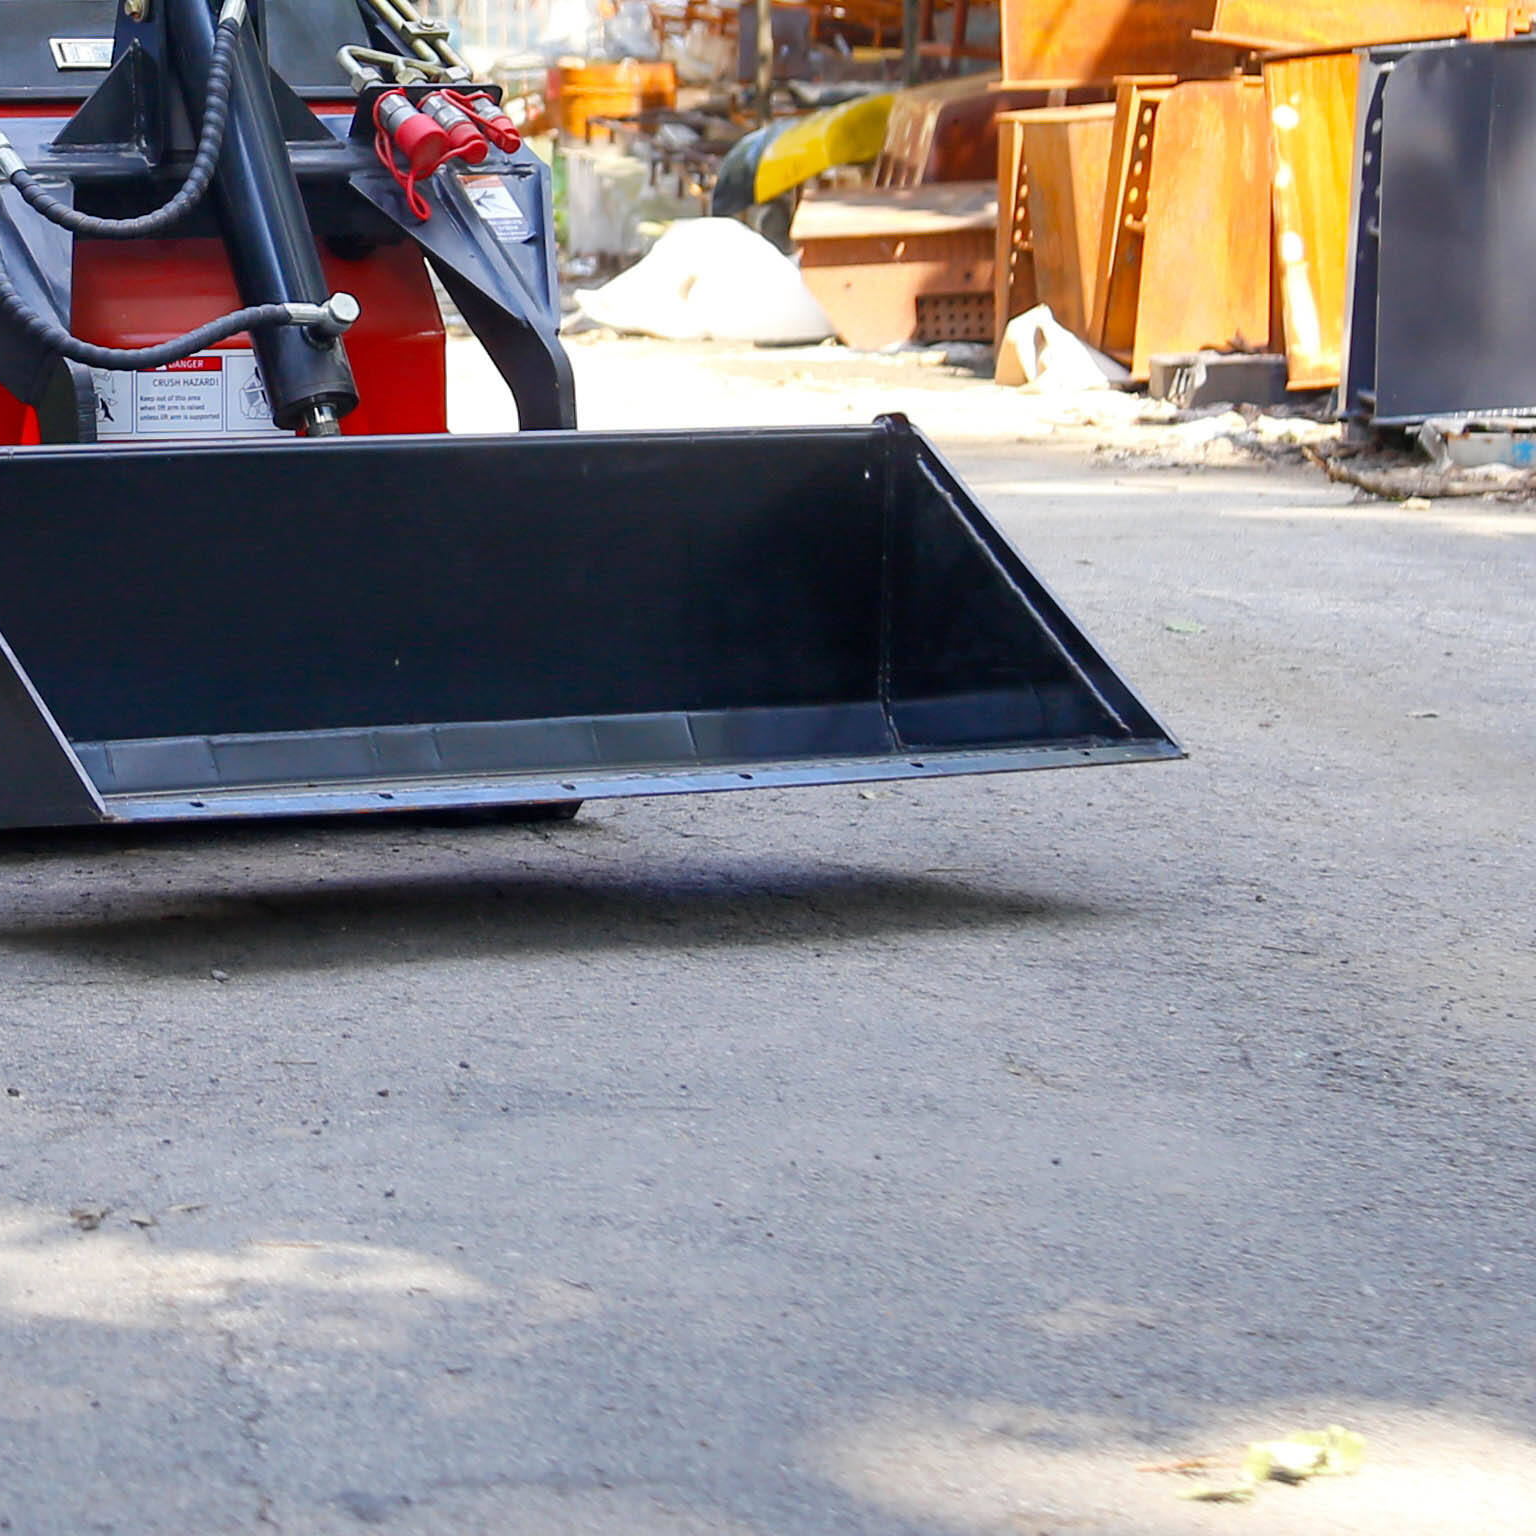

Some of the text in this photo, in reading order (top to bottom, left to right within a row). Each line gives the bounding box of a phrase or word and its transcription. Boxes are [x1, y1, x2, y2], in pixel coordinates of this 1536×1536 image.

[168, 360, 204, 368] DANGER
[152, 377, 219, 387] CRUSH HAZARD!
